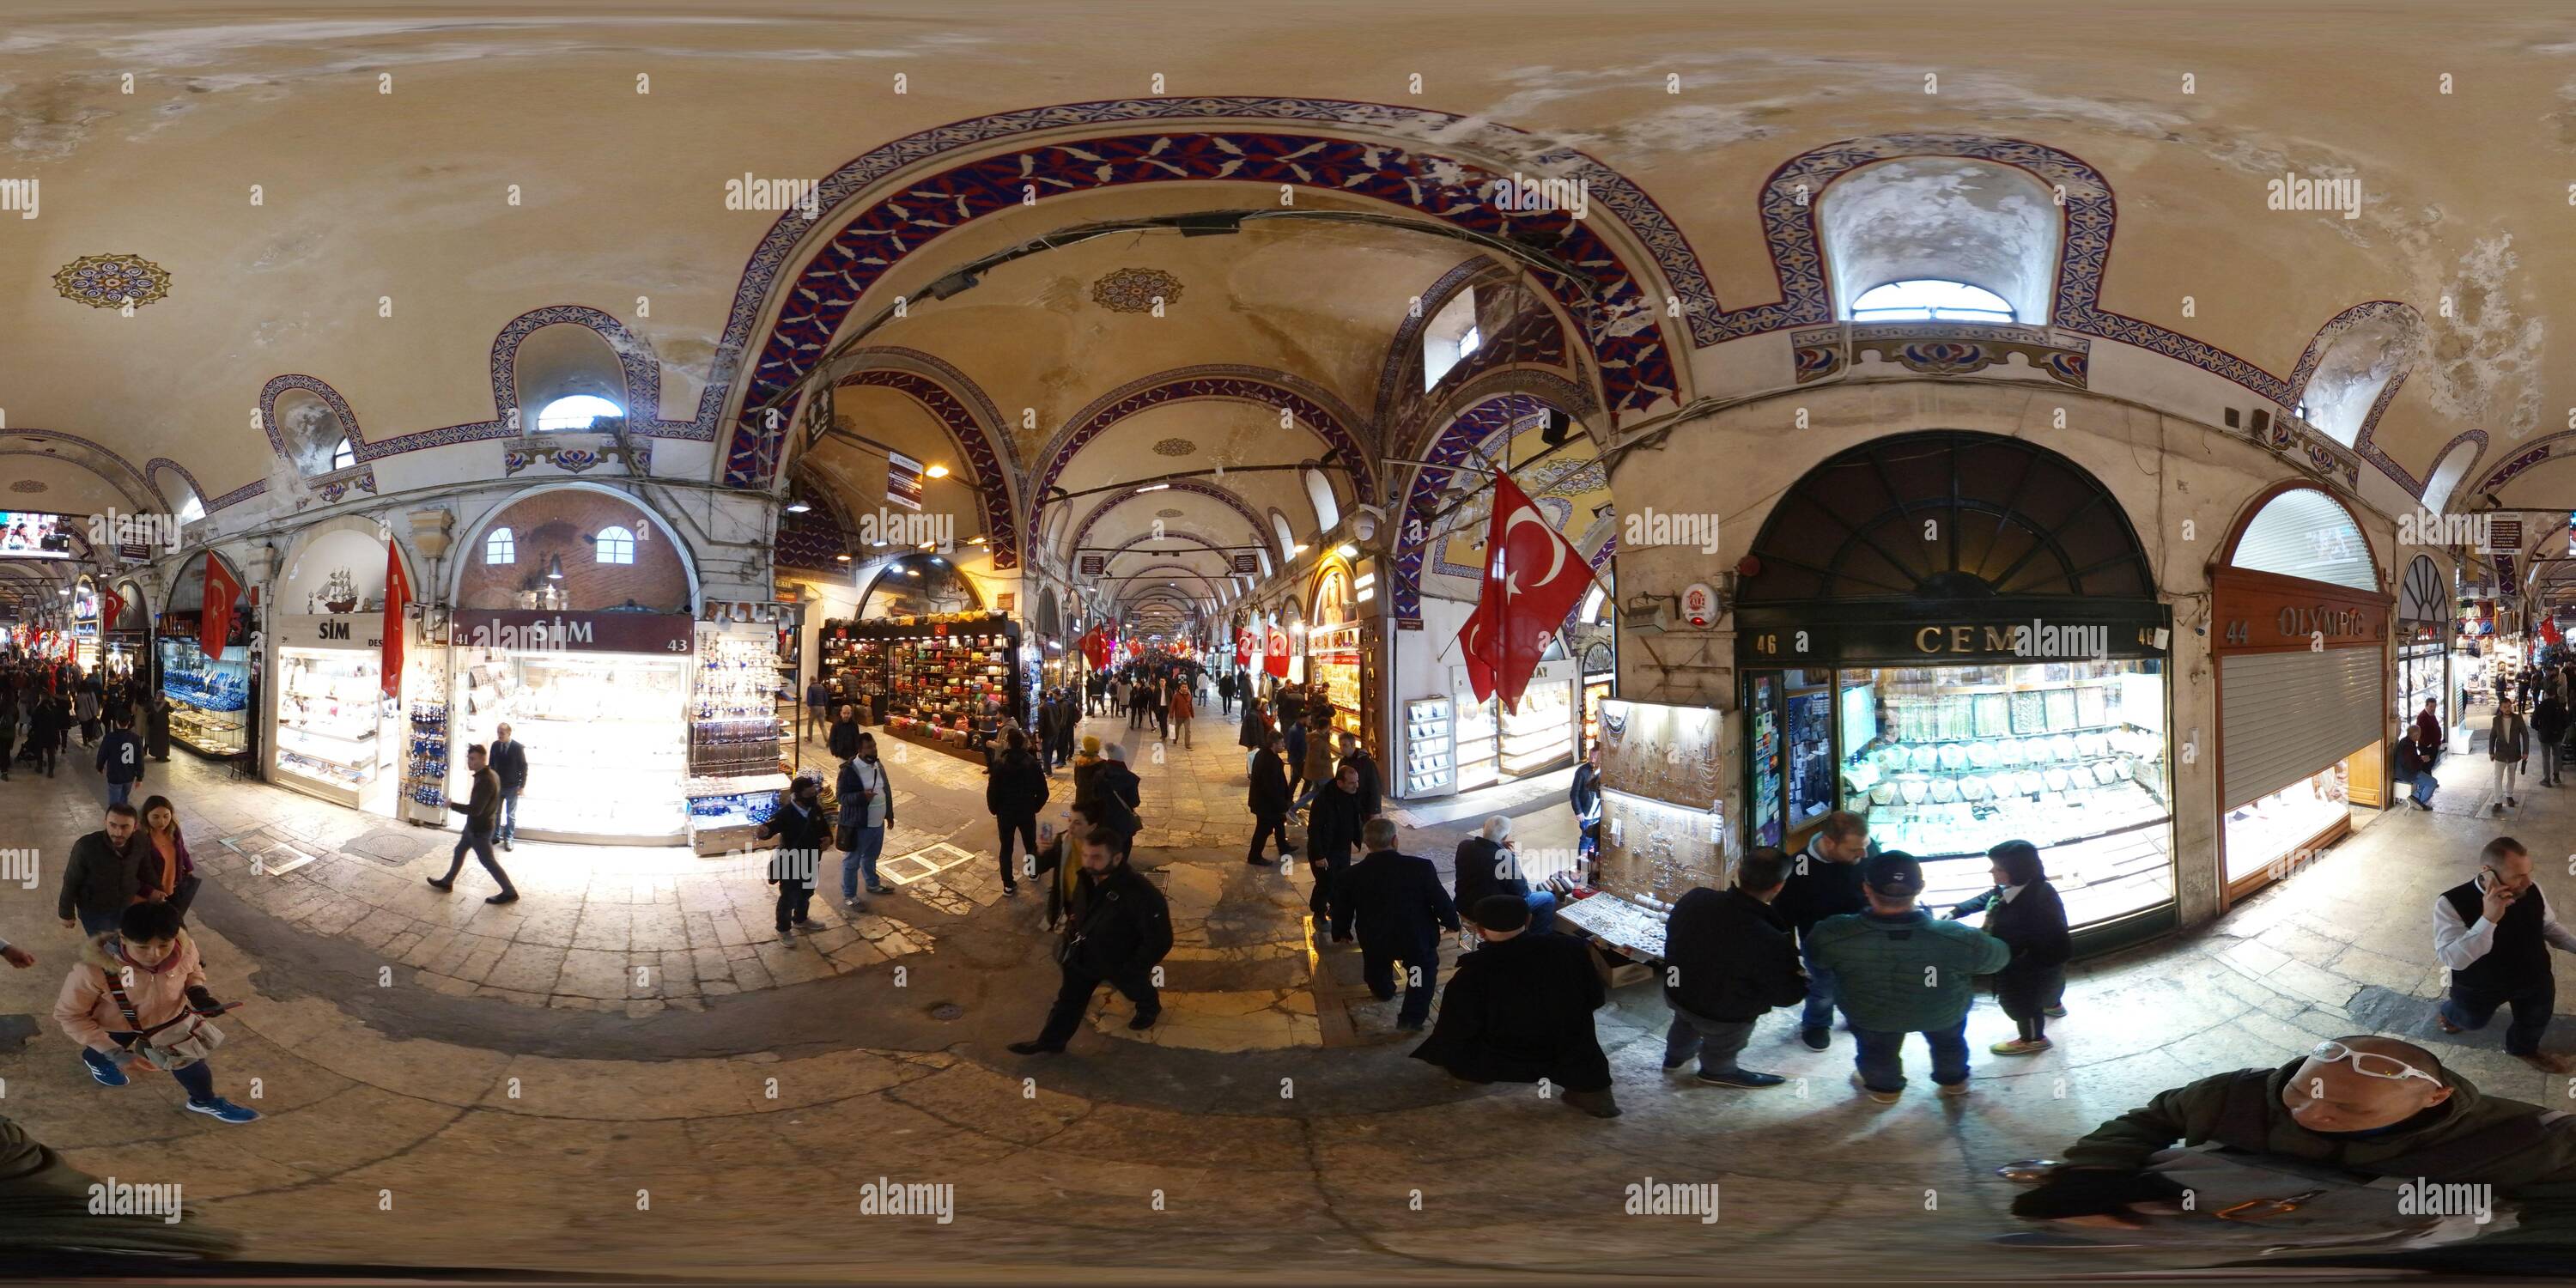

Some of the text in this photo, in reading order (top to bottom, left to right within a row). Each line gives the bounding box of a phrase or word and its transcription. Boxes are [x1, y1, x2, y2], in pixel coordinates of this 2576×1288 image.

[319, 618, 350, 640] SİM
[455, 633, 469, 645] 41
[532, 615, 594, 644] SİM
[1916, 626, 2019, 653] CEM
[2227, 619, 2249, 645] 44
[666, 639, 689, 653] 43
[1757, 634, 1777, 654] 46
